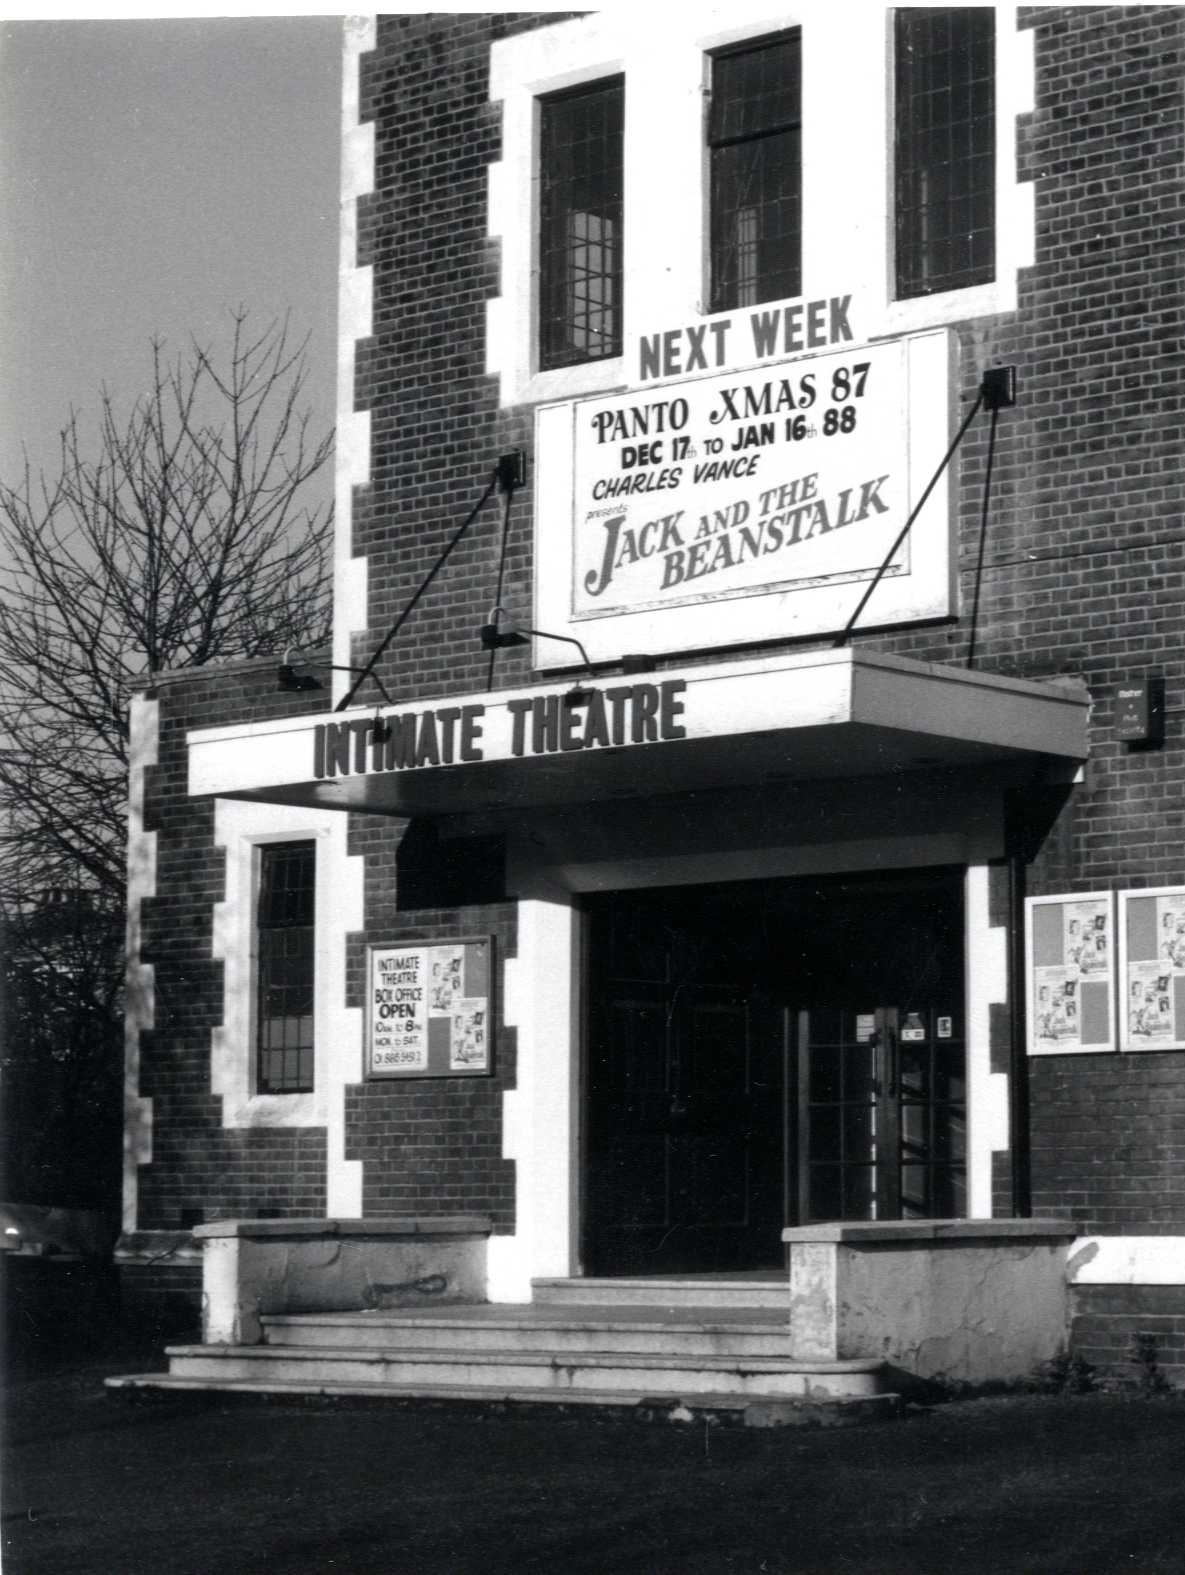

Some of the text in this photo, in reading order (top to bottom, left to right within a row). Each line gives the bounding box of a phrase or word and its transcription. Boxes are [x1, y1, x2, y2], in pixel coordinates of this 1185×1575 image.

[639, 294, 854, 380] NEXT WEEK
[591, 362, 872, 444] PANTO XMAS 87
[621, 440, 663, 470] DEC
[703, 437, 724, 455] TO
[731, 422, 775, 452] JAN
[822, 405, 857, 436] 88
[591, 454, 761, 501] CHARLES VANCE
[584, 503, 630, 524] presents
[584, 472, 820, 597] JACK AND THE
[659, 473, 891, 591] BEANSTALK
[507, 679, 687, 756] THEATRE
[379, 1003, 416, 1019] OPEN
[380, 971, 418, 986] THEATRE
[394, 987, 423, 1003] OFFICE
